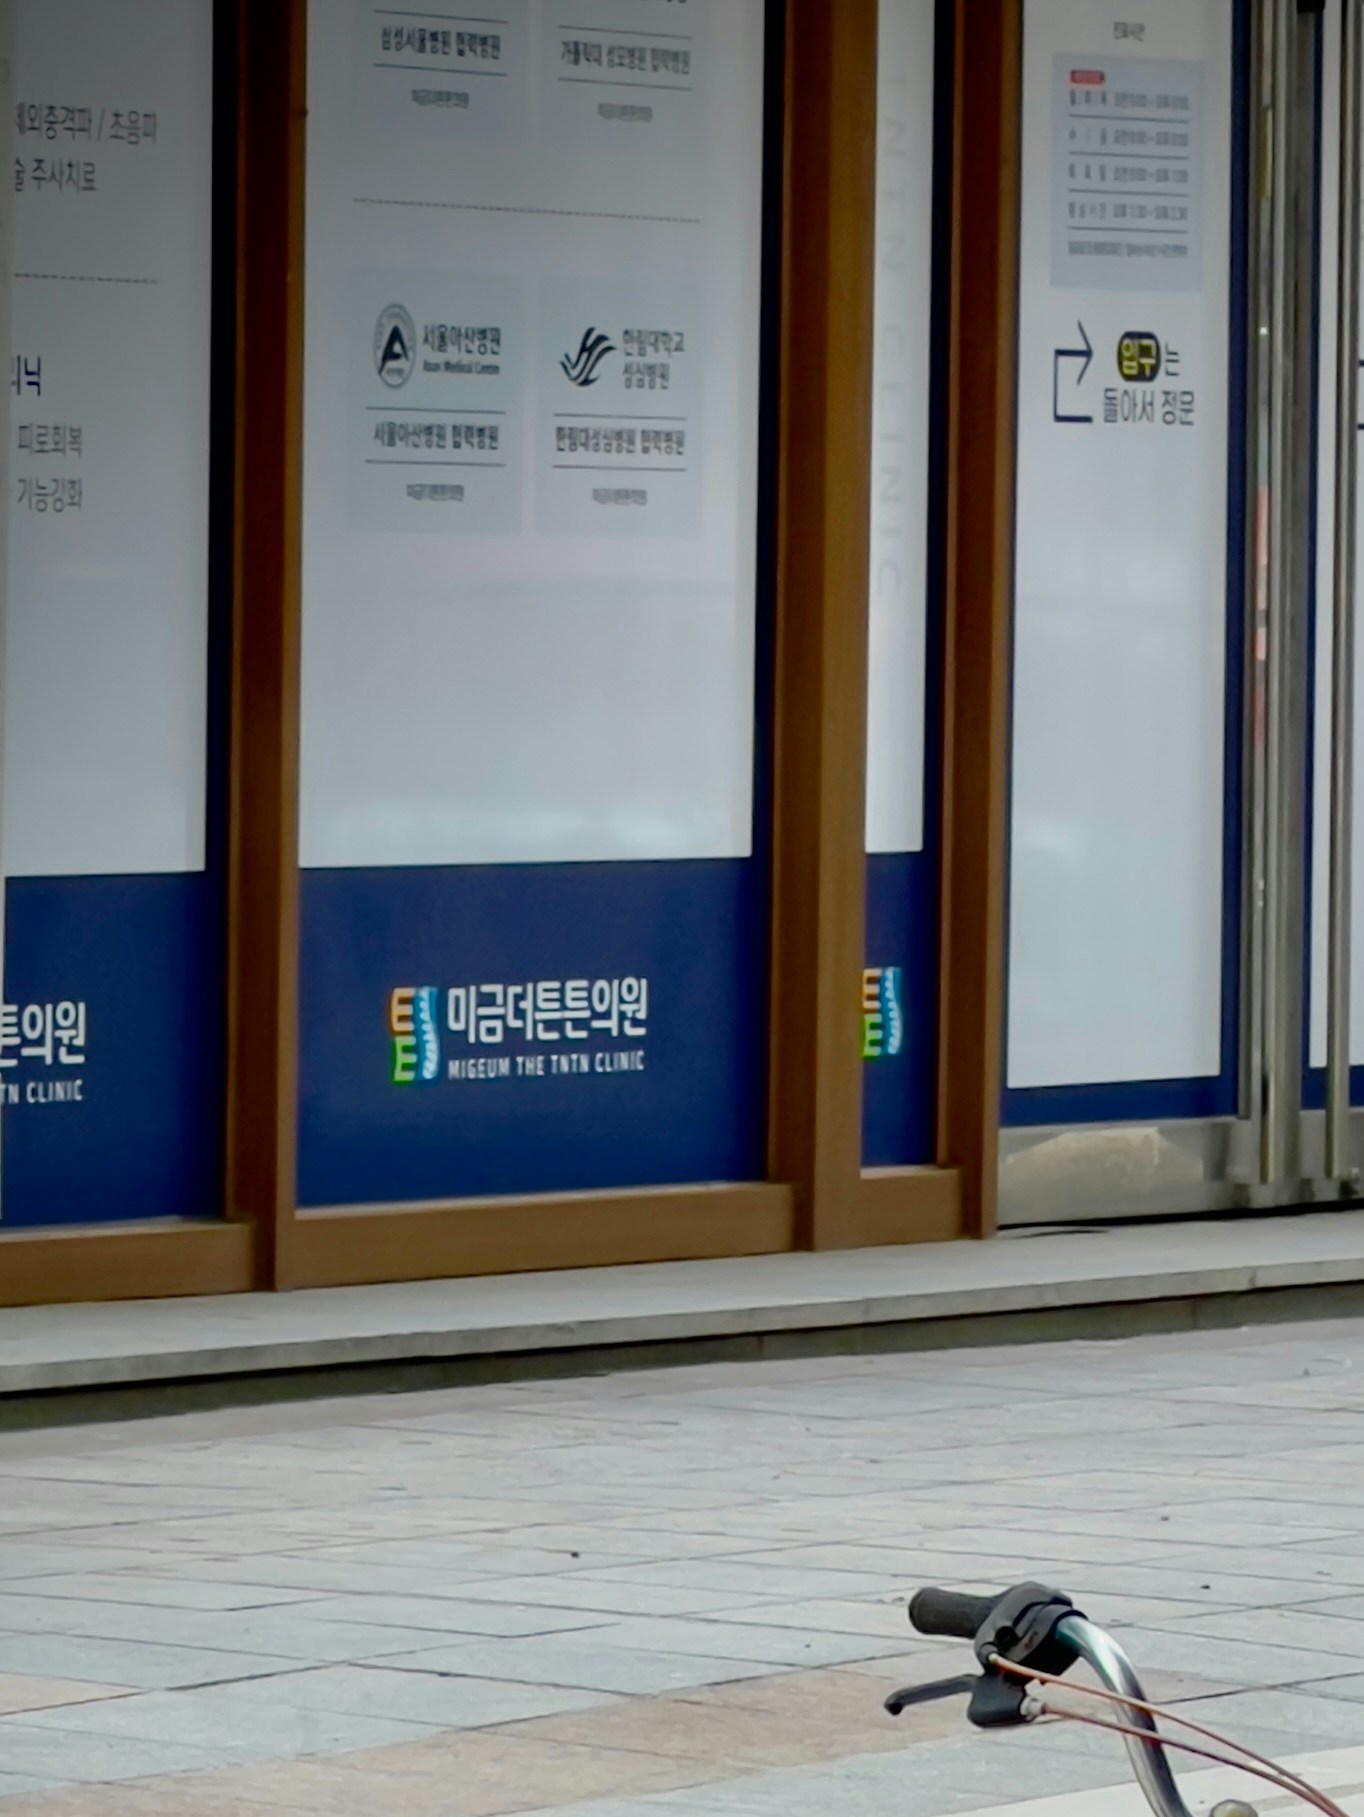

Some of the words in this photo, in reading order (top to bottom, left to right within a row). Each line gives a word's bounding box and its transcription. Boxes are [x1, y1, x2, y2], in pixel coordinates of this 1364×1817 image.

[110, 108, 157, 145] 초음파
[31, 158, 97, 193] 주사치료
[423, 324, 500, 355] 서울아산병원
[1104, 388, 1155, 423] 돌아서
[1161, 390, 1194, 426] 정문
[17, 476, 82, 513] 기능강화
[448, 976, 648, 1044] 미금더튼튼의원
[448, 1056, 510, 1080] MIGEUM
[516, 1054, 545, 1076] THE
[551, 1053, 589, 1074] TNTN
[595, 1050, 645, 1073] CLINIC
[26, 1079, 83, 1103] CLINIC
